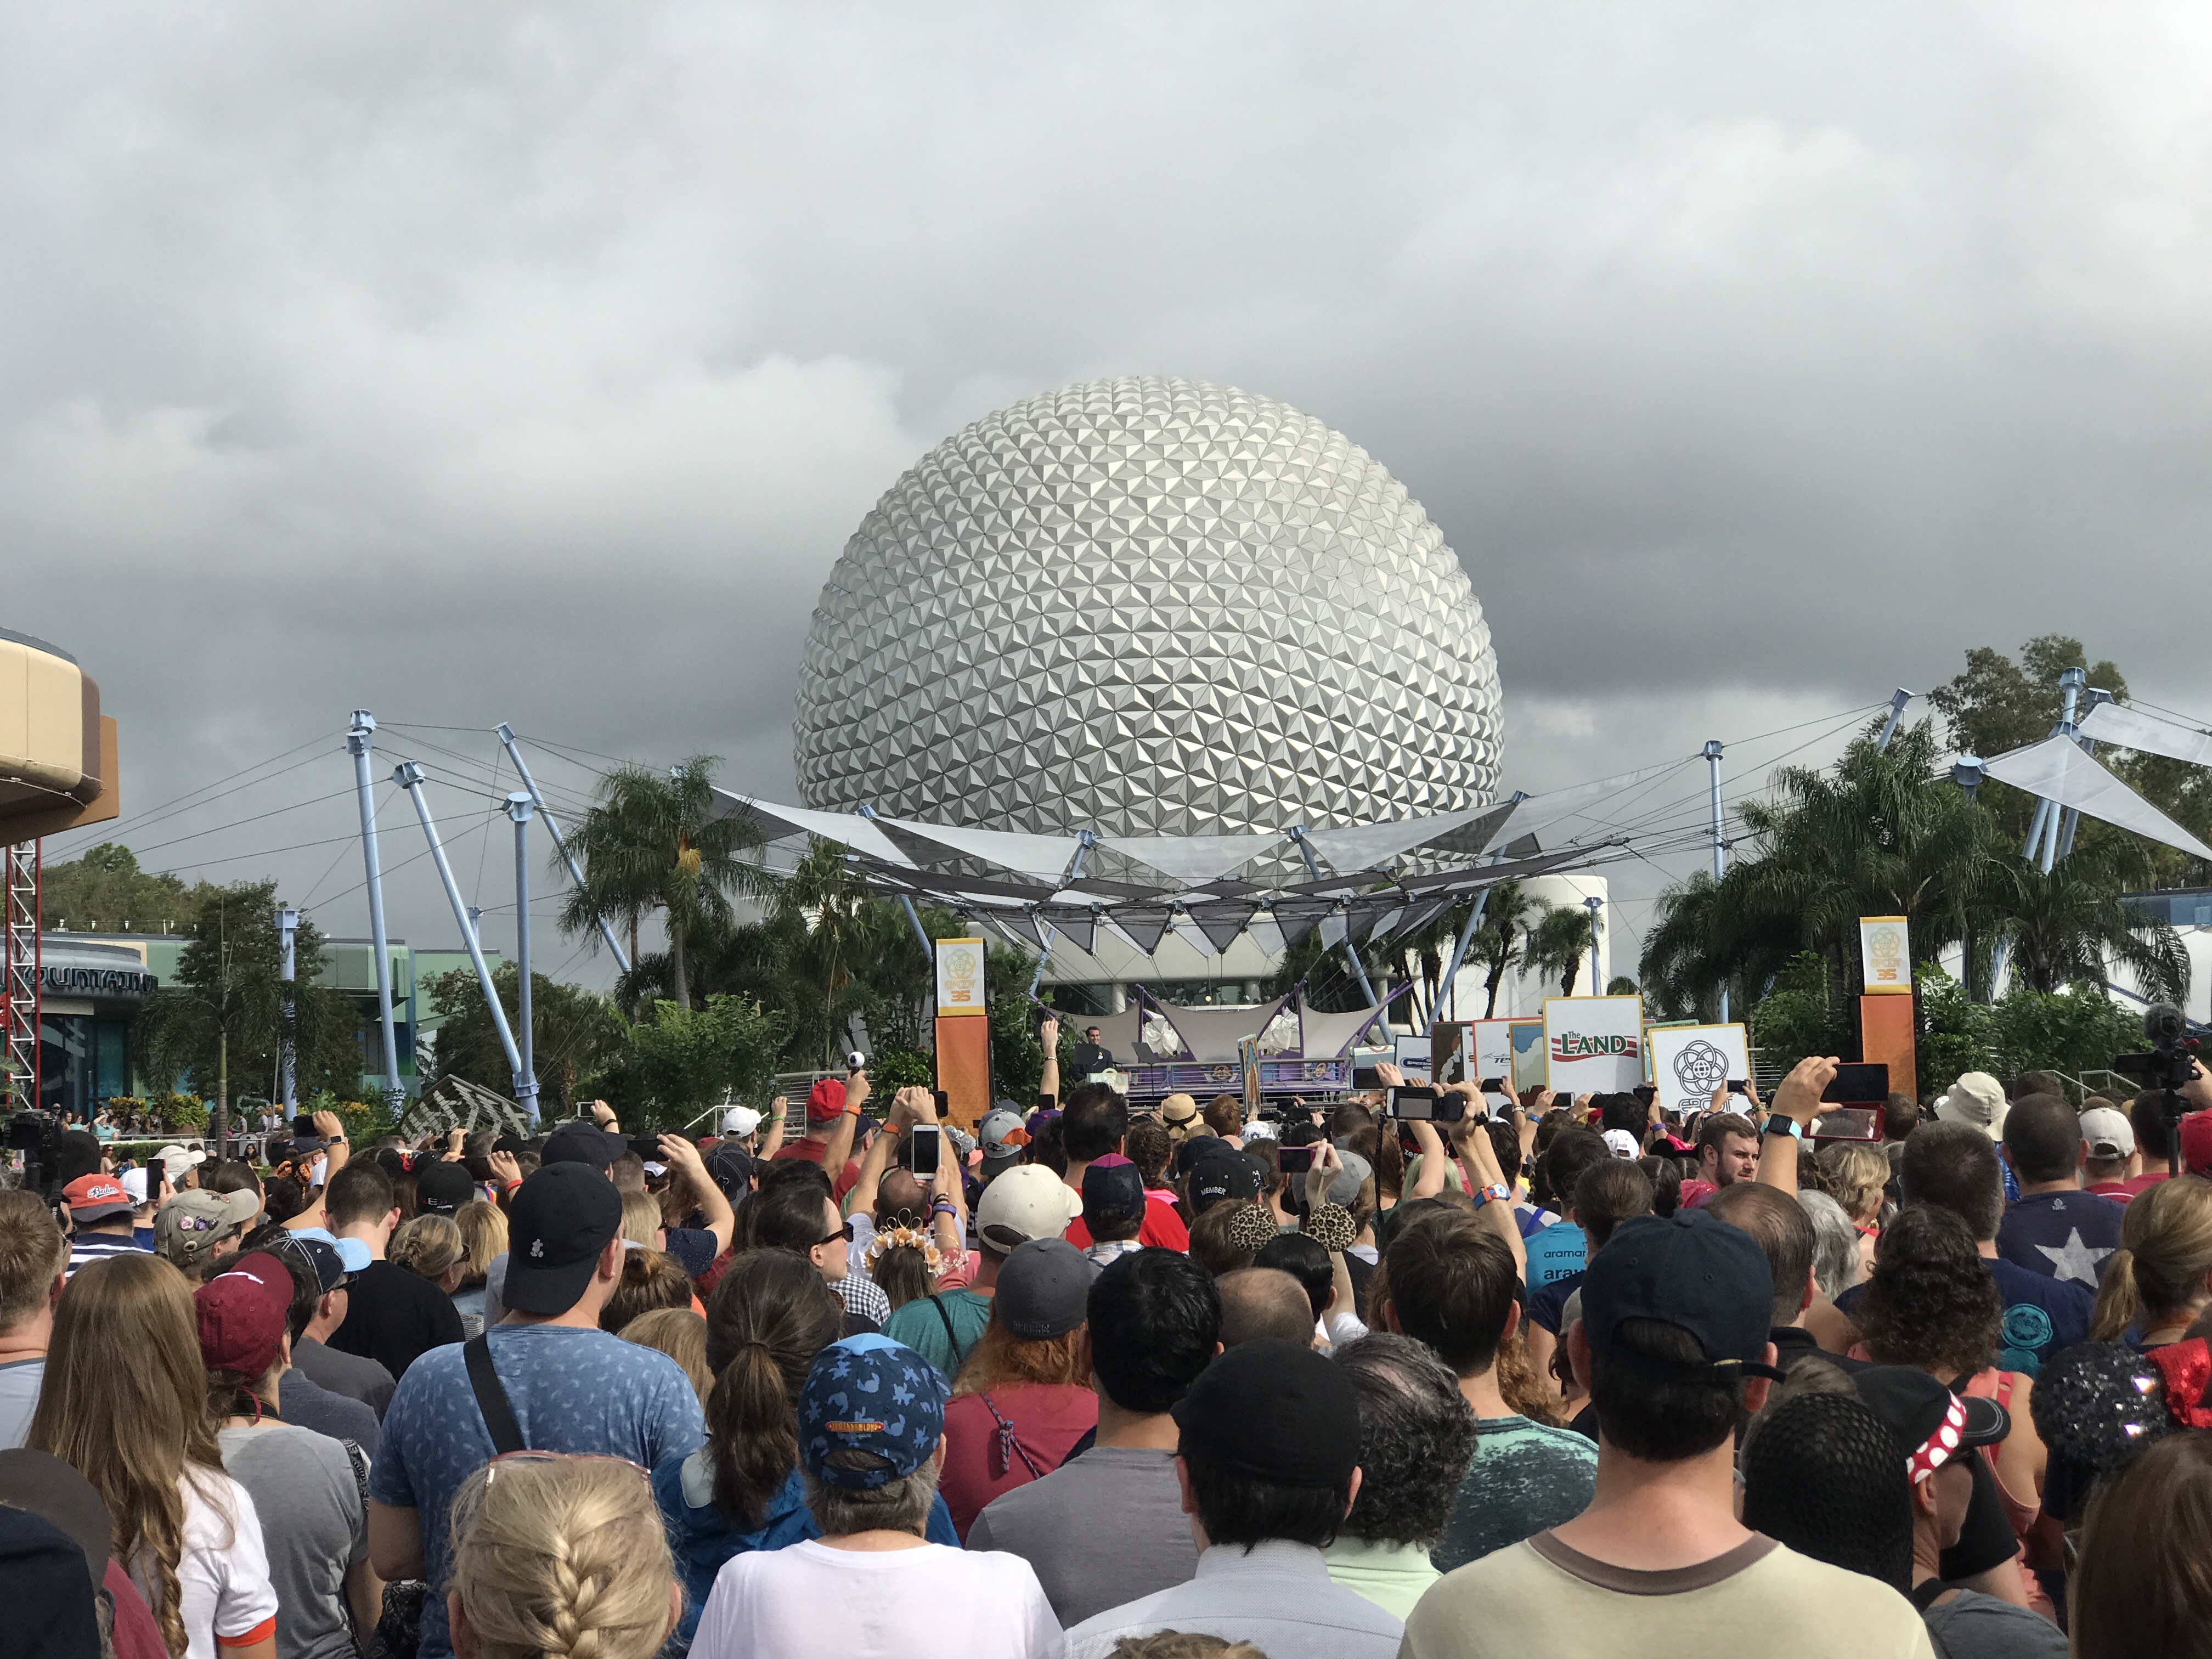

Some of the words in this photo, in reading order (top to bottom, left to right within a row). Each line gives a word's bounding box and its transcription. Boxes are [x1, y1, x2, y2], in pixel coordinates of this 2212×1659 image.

[5, 966, 141, 990] OUNTAIN
[1876, 969, 1897, 980] 35
[951, 990, 971, 1002] 35
[1567, 1030, 1581, 1039] The
[1561, 1034, 1627, 1054] LAND
[1404, 1149, 1419, 1159] zer
[1200, 1187, 1227, 1196] MEMBER
[1544, 1250, 1587, 1259] aramar
